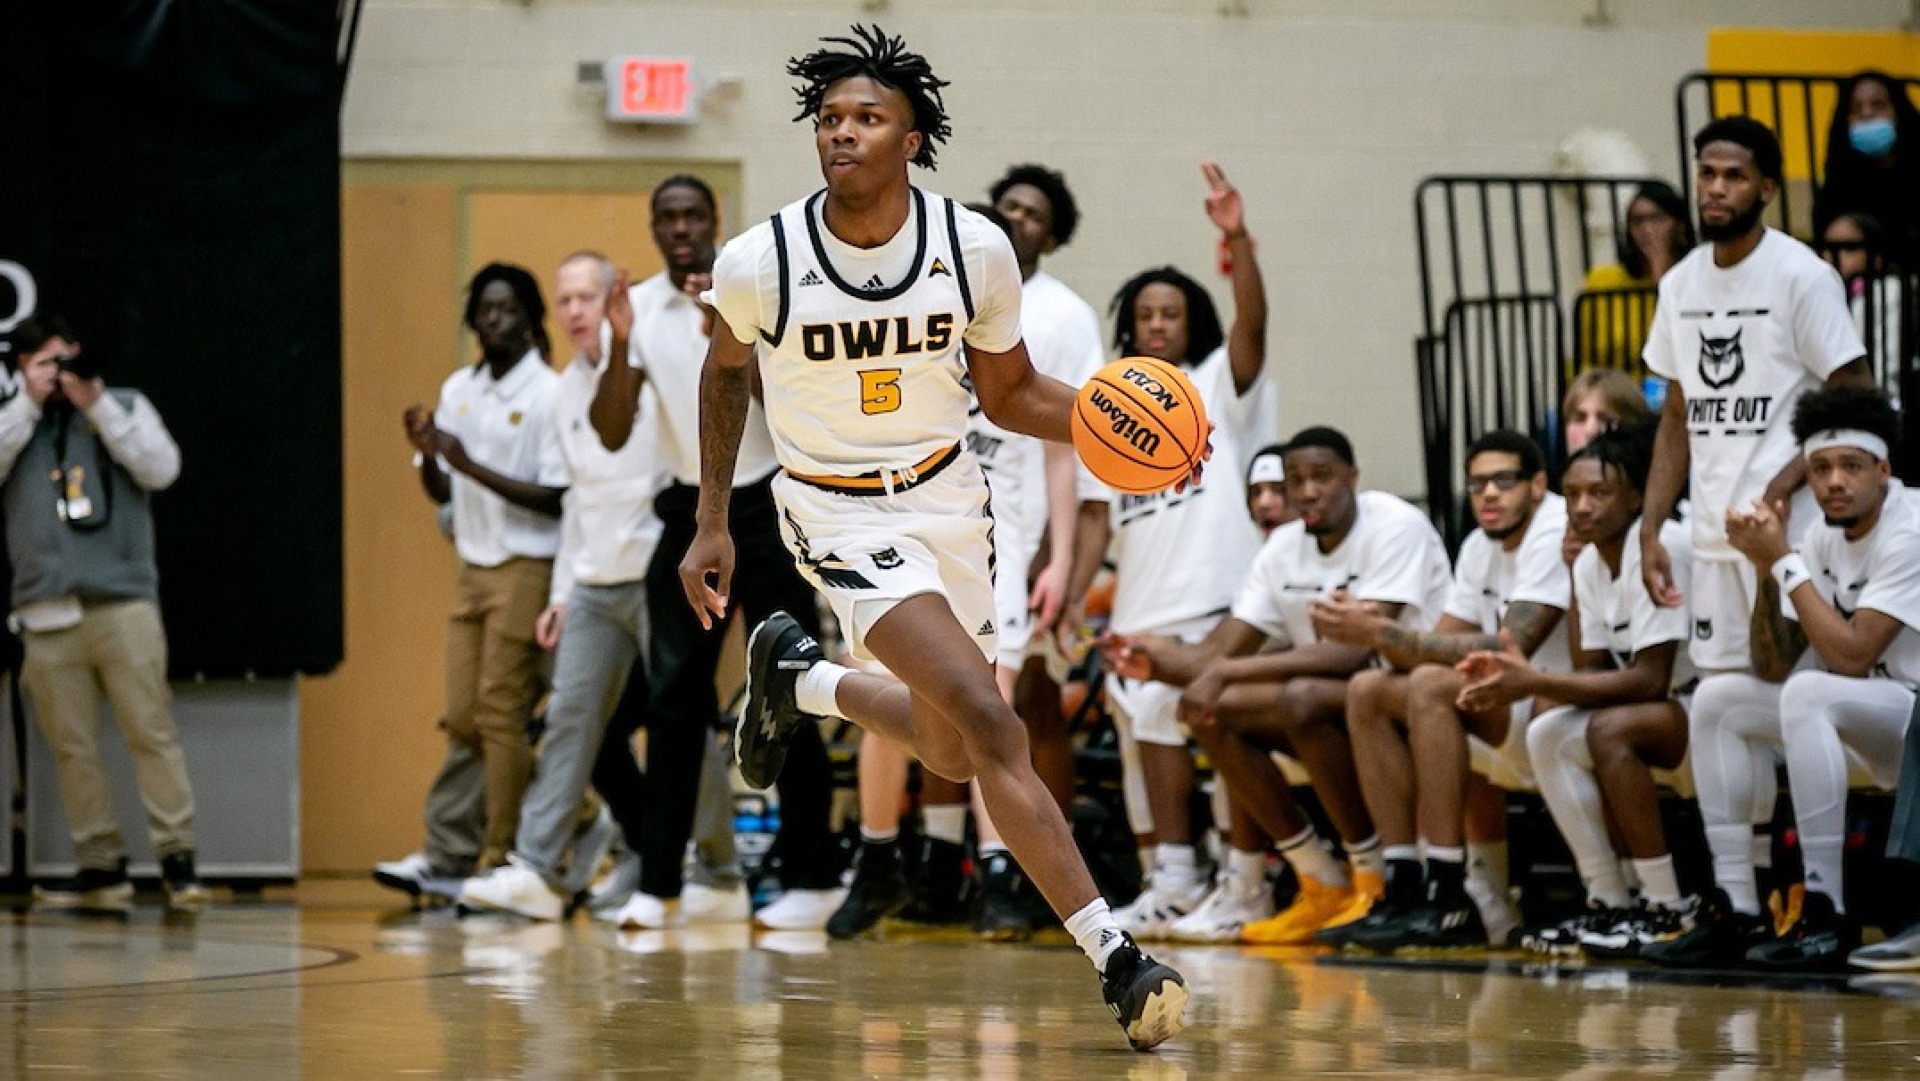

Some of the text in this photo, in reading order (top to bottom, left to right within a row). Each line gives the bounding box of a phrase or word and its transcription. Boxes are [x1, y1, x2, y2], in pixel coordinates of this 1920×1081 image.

[622, 59, 687, 115] EXIT
[801, 313, 953, 361] OWLS
[857, 368, 902, 416] 5
[1122, 366, 1180, 412] NCAA
[1733, 396, 1772, 422] OUT
[1089, 387, 1161, 457] Wilson
